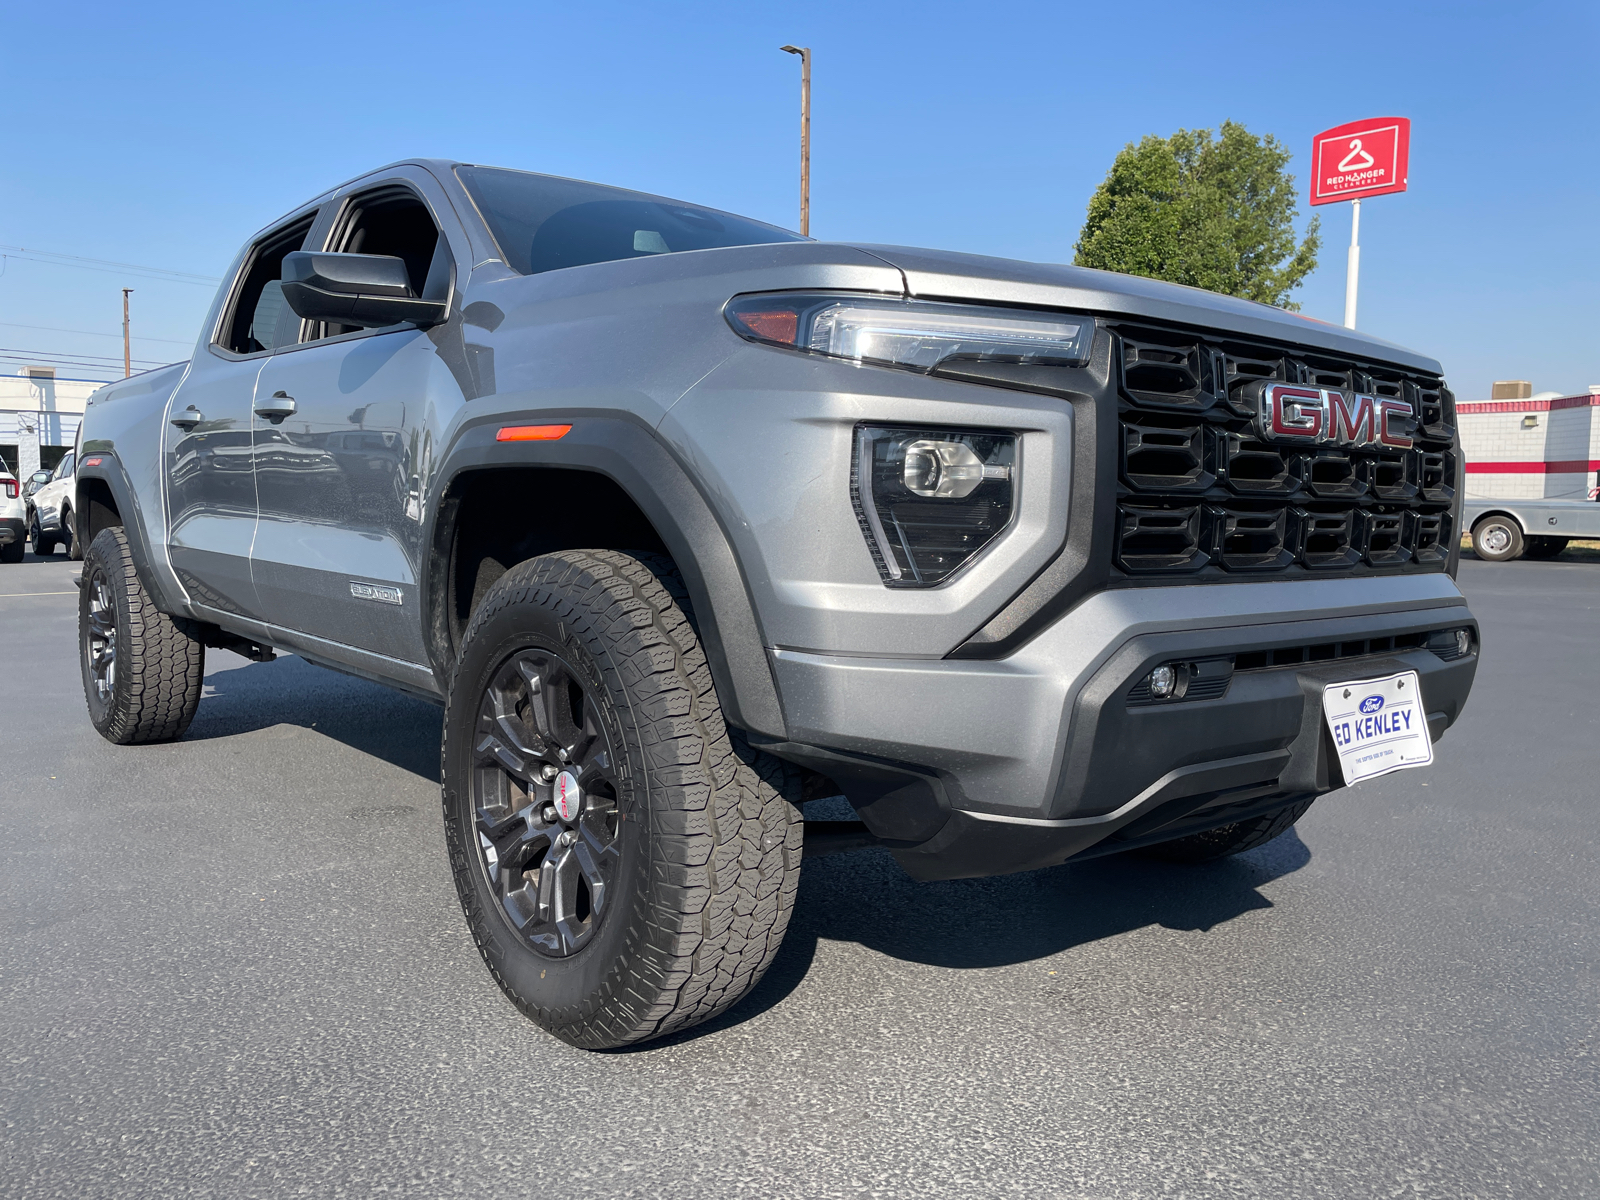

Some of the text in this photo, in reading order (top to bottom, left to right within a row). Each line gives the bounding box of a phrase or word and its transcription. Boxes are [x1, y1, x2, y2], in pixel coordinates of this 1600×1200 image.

[1326, 168, 1385, 186] RED HANGER
[1333, 178, 1377, 190] CLEANERS
[1264, 383, 1414, 449] GMC
[352, 584, 399, 602] ELEVATION
[1362, 697, 1382, 713] Ford
[1334, 709, 1412, 747] ED KENLEY
[560, 775, 569, 818] GMC
